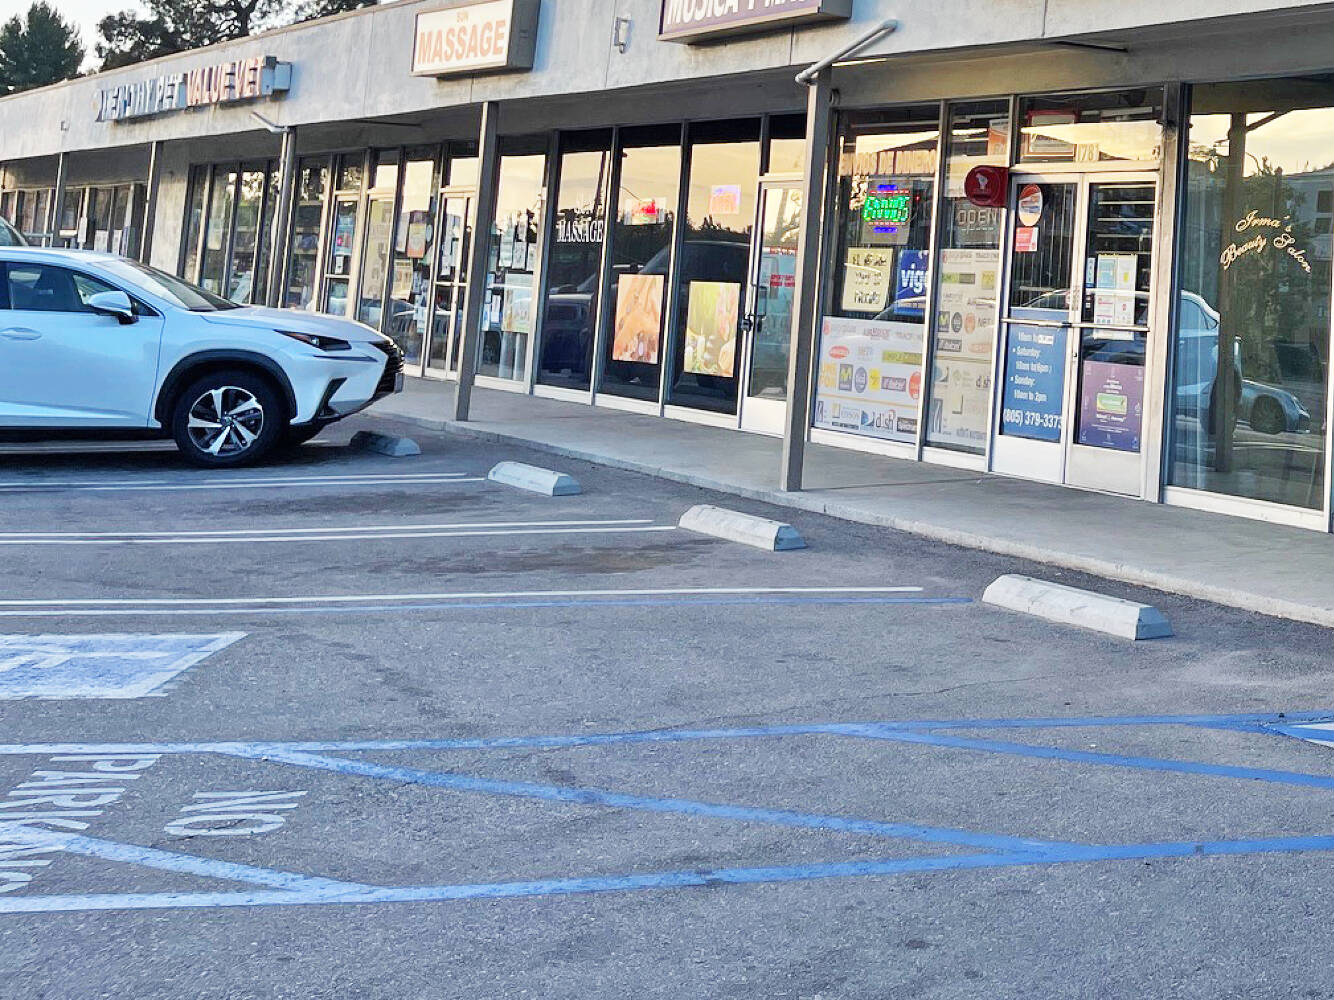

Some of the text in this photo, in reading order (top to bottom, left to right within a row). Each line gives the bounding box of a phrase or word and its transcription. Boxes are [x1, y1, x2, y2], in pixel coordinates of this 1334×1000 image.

[417, 19, 506, 65] MASSAGE
[186, 62, 234, 106] VALUE
[234, 55, 265, 98] VET
[957, 209, 998, 225] OPEN
[1220, 233, 1311, 273] Beauty Salon
[1003, 409, 1024, 427] (805)
[0, 753, 163, 895] PARKN
[163, 790, 308, 837] NO
